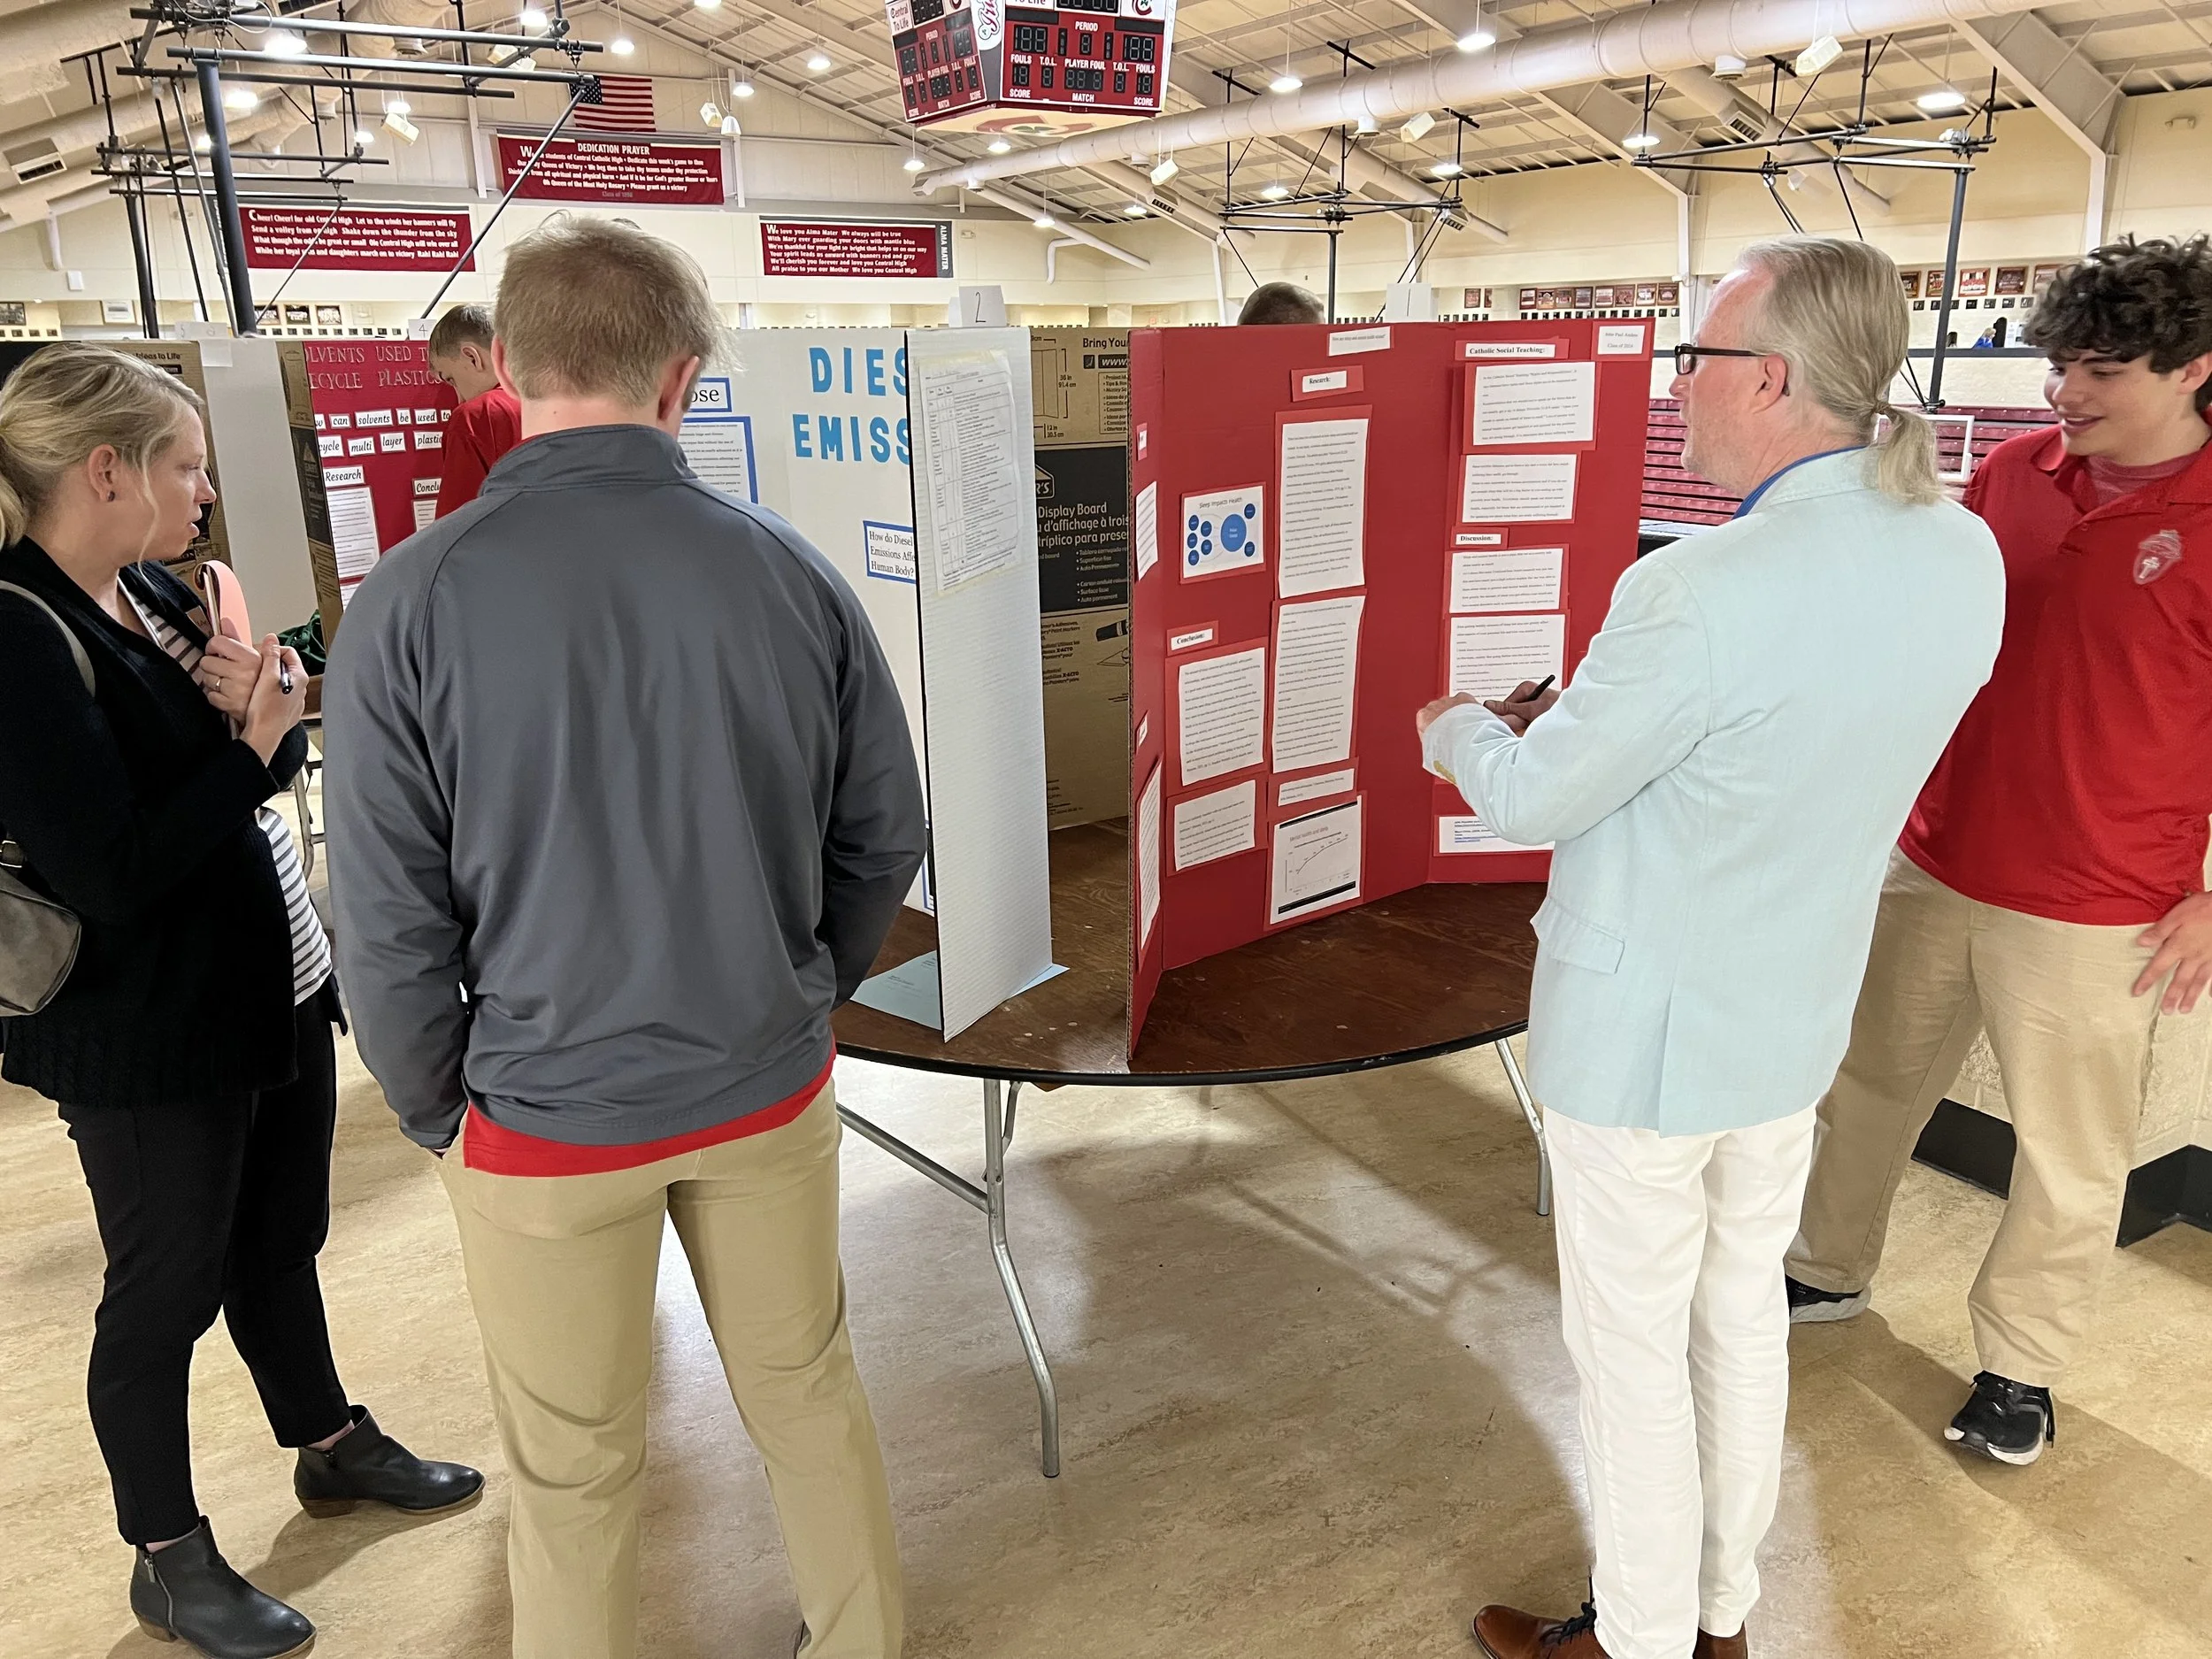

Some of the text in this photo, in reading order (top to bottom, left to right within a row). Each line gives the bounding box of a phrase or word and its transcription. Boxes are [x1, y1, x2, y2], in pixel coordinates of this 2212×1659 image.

[890, 6, 908, 19] Central
[894, 21, 901, 31] To
[1075, 21, 1098, 32] PERIOD
[1010, 54, 1156, 73] FOULS T.O.L. PLAYER FOUL T.O.L. FOULS
[1010, 88, 1154, 106] SCORE MATCH SCORE
[577, 142, 650, 155] DEDICATION PRAYER
[338, 216, 352, 225] High
[766, 224, 779, 234] We
[976, 291, 987, 323] 2
[419, 324, 428, 338] 4
[1083, 337, 1107, 349] Bring
[375, 346, 411, 362] USED
[418, 347, 428, 362] T
[809, 346, 907, 396] DIES
[358, 414, 390, 425] solvents
[400, 413, 409, 422] be
[418, 412, 435, 421] used
[351, 441, 372, 452] multi
[382, 436, 403, 449] layer
[792, 413, 910, 465] EMISS
[326, 469, 361, 481] Research
[1038, 501, 1107, 519] Display Board
[1044, 518, 1099, 532] d'affichage
[1100, 517, 1107, 527] à
[869, 531, 913, 546] How do Diesel
[1074, 534, 1098, 547] para
[870, 545, 901, 559] Emissions
[872, 560, 914, 578] Human Body?
